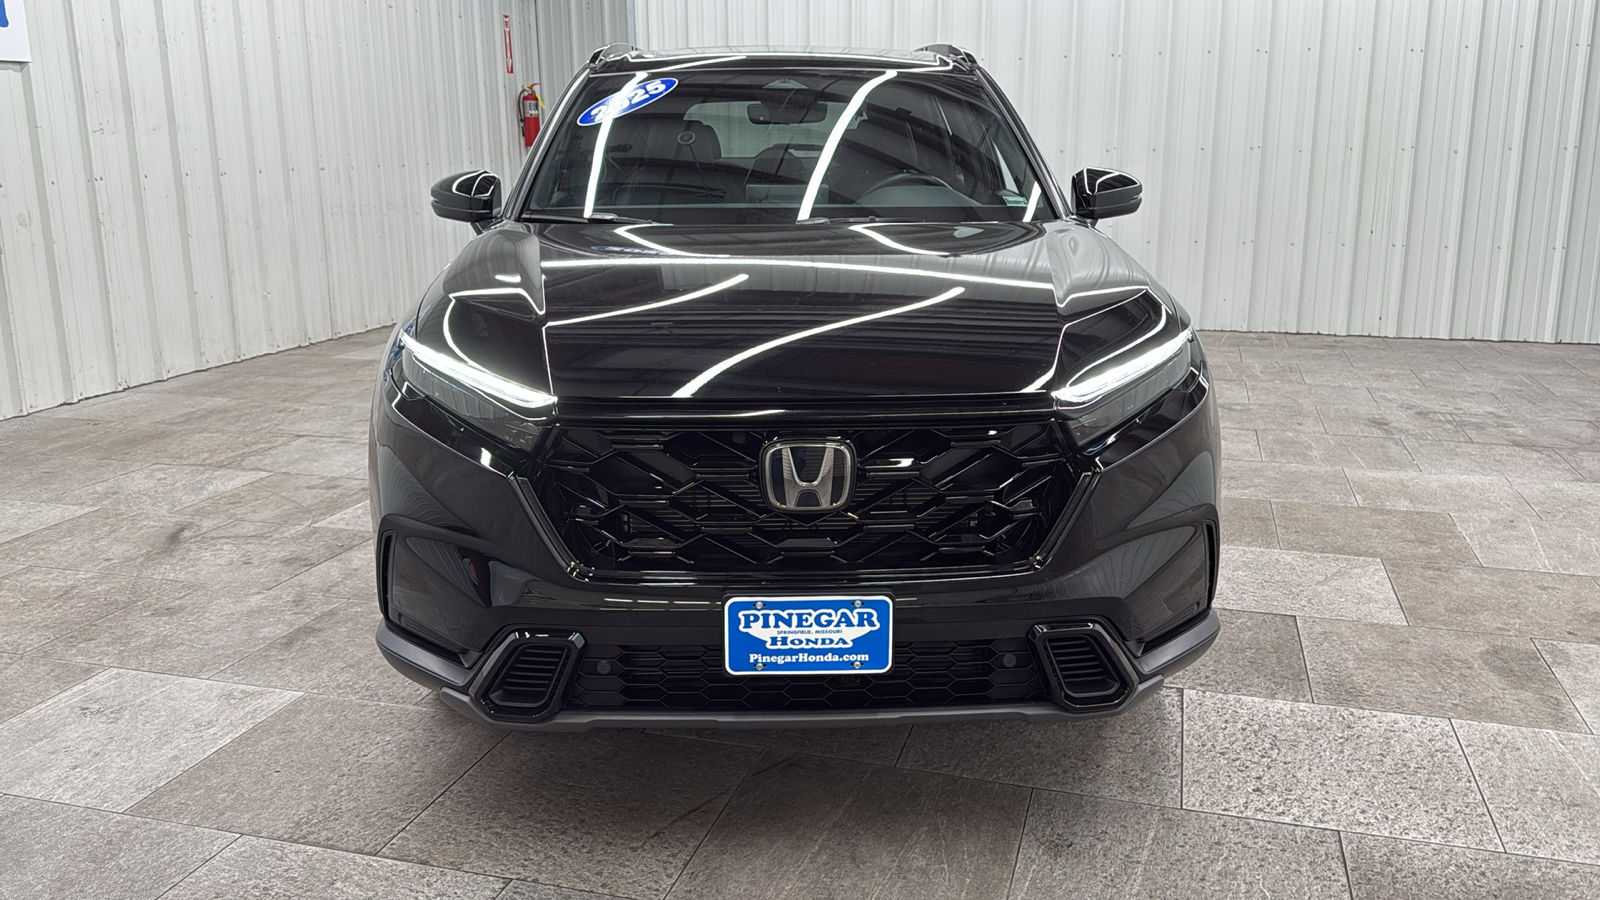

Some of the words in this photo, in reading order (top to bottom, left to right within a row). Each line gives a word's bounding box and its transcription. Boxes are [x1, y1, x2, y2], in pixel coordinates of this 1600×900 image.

[590, 80, 667, 122] 2025
[741, 611, 877, 629] PINEGAR
[749, 653, 870, 664] PinegarHonda.com
